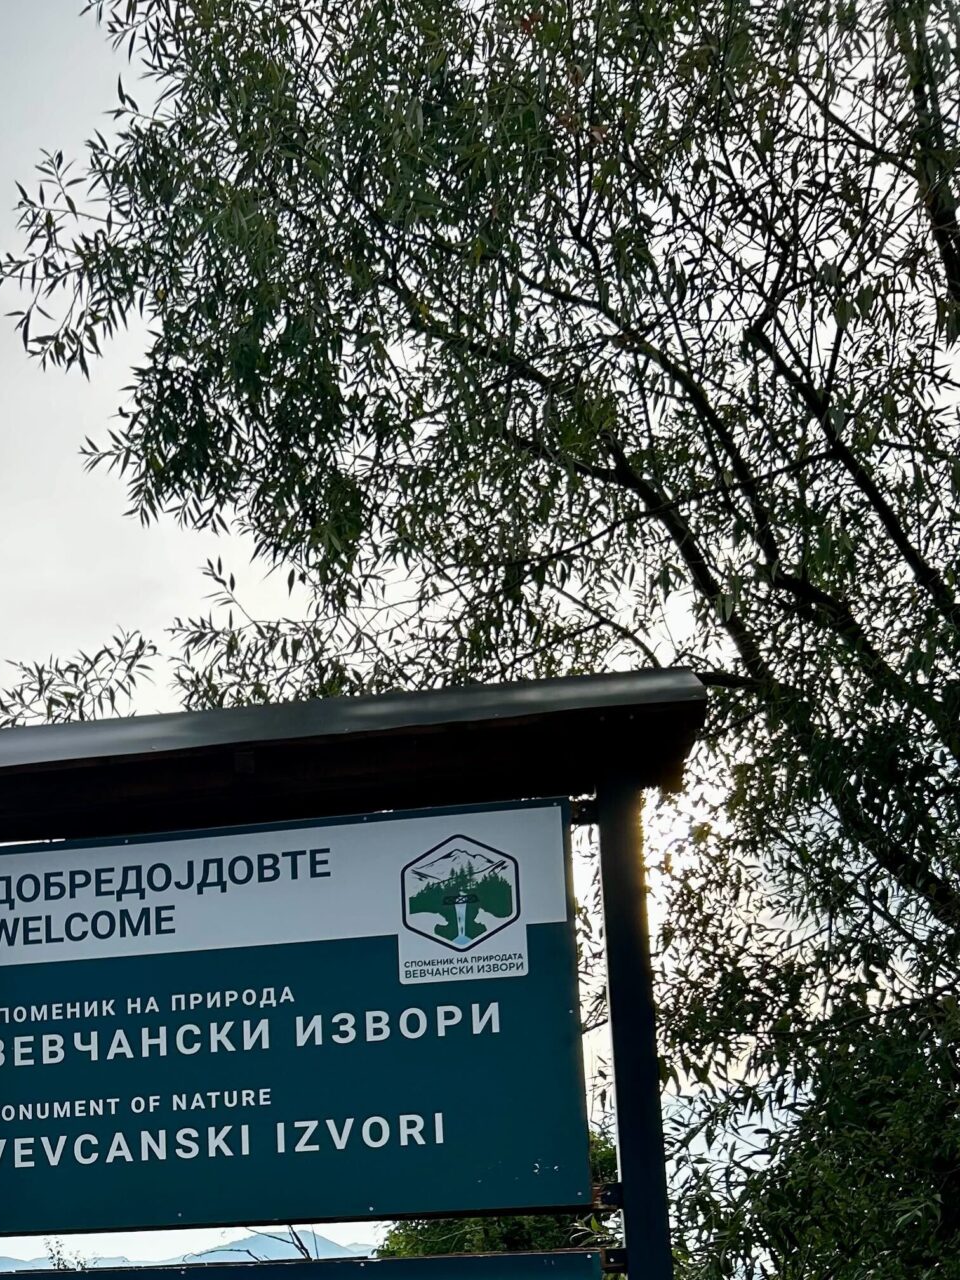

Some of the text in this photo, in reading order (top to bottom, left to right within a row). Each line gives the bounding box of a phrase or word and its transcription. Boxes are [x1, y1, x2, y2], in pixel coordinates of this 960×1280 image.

[404, 958, 454, 968] СПОМЕНИК
[471, 953, 523, 963] ПРИРОДАТА
[405, 962, 524, 979] ВЕВЧАНСКИ ИЗВОРИ
[127, 996, 160, 1015] НА
[171, 985, 295, 1012] ПРИРОДА
[295, 1001, 501, 1048] ИЗВОРИ
[130, 1095, 161, 1114] OF
[172, 1088, 272, 1111] NATURE
[276, 1112, 444, 1154] IZVORI
